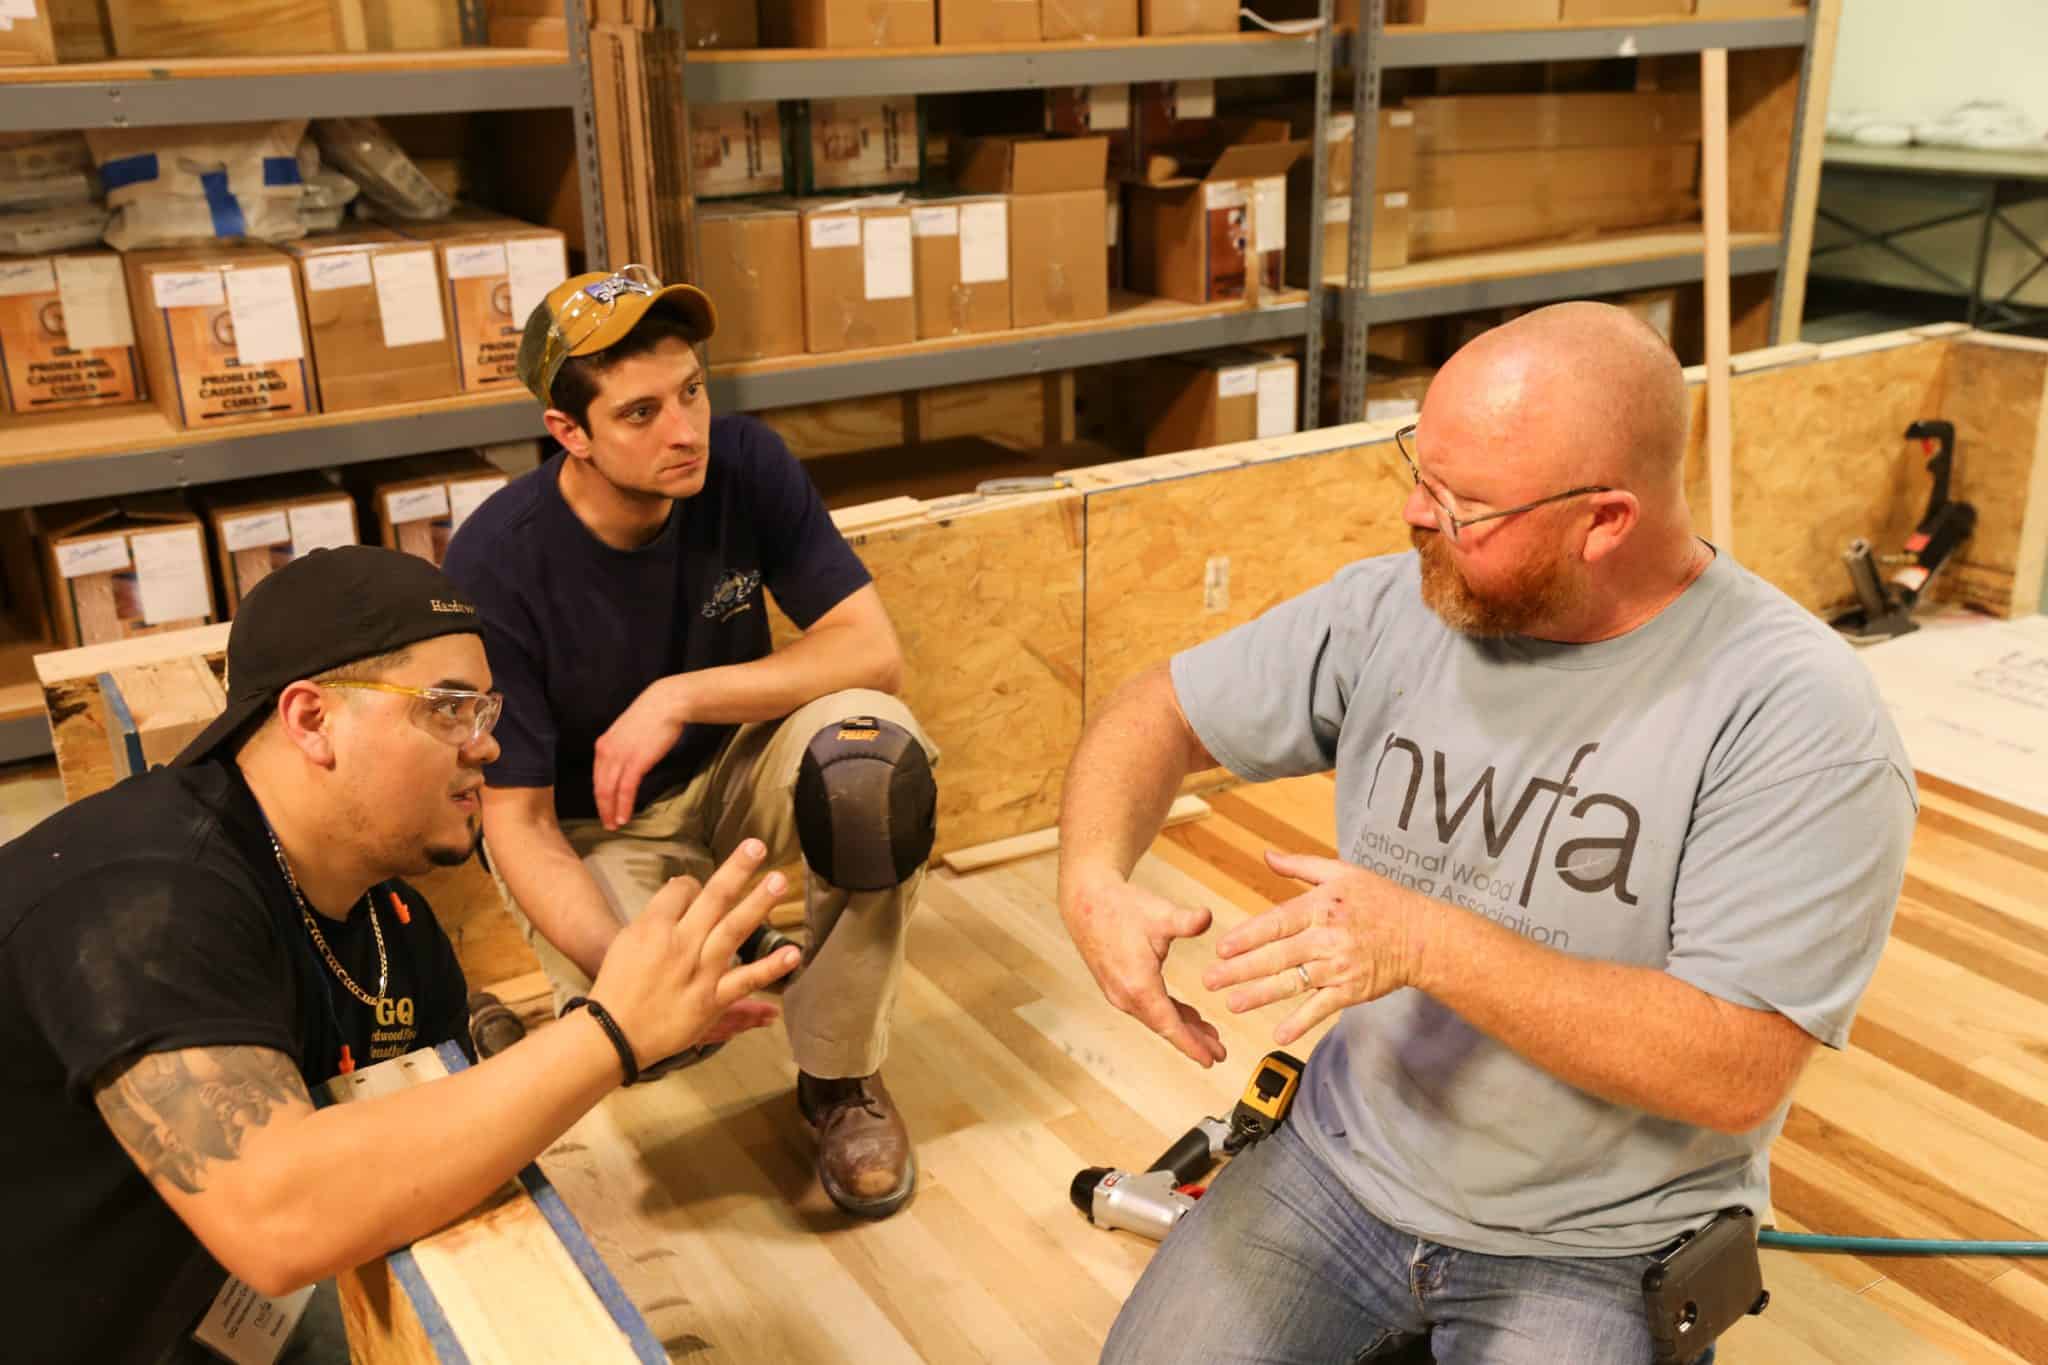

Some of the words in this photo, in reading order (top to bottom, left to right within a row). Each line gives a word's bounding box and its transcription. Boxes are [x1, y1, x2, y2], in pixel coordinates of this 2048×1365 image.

[86, 368, 116, 379] AND
[199, 384, 254, 399] CAUSES
[257, 381, 288, 393] AND
[222, 396, 268, 409] CURES
[1368, 731, 1641, 909] nwfa
[1452, 862, 1515, 902] Wood
